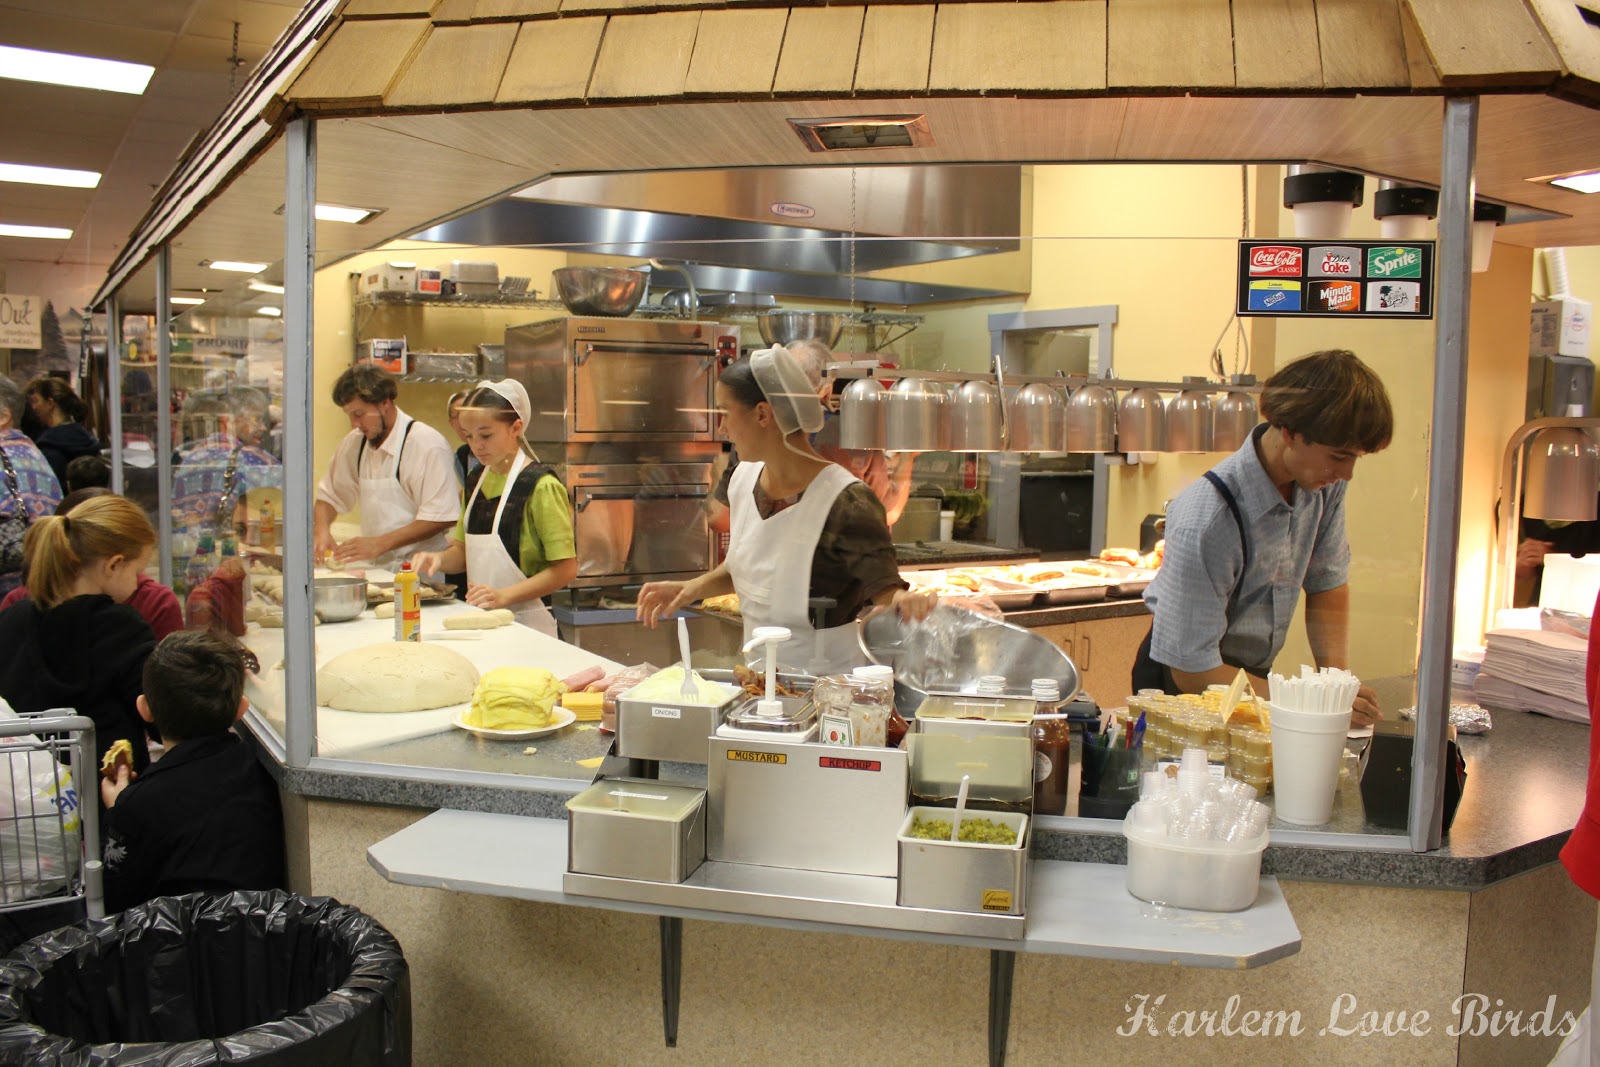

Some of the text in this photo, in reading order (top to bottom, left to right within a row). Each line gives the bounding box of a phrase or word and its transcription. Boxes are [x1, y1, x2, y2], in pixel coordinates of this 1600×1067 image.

[1332, 255, 1350, 263] Diet
[1374, 251, 1416, 276] Sprite
[1321, 261, 1350, 273] Coke
[1319, 285, 1353, 300] Minute
[1328, 292, 1352, 307] Maid
[654, 708, 678, 717] ONIONS
[734, 752, 780, 763] MUSTARD
[829, 758, 872, 770] KETCHUP
